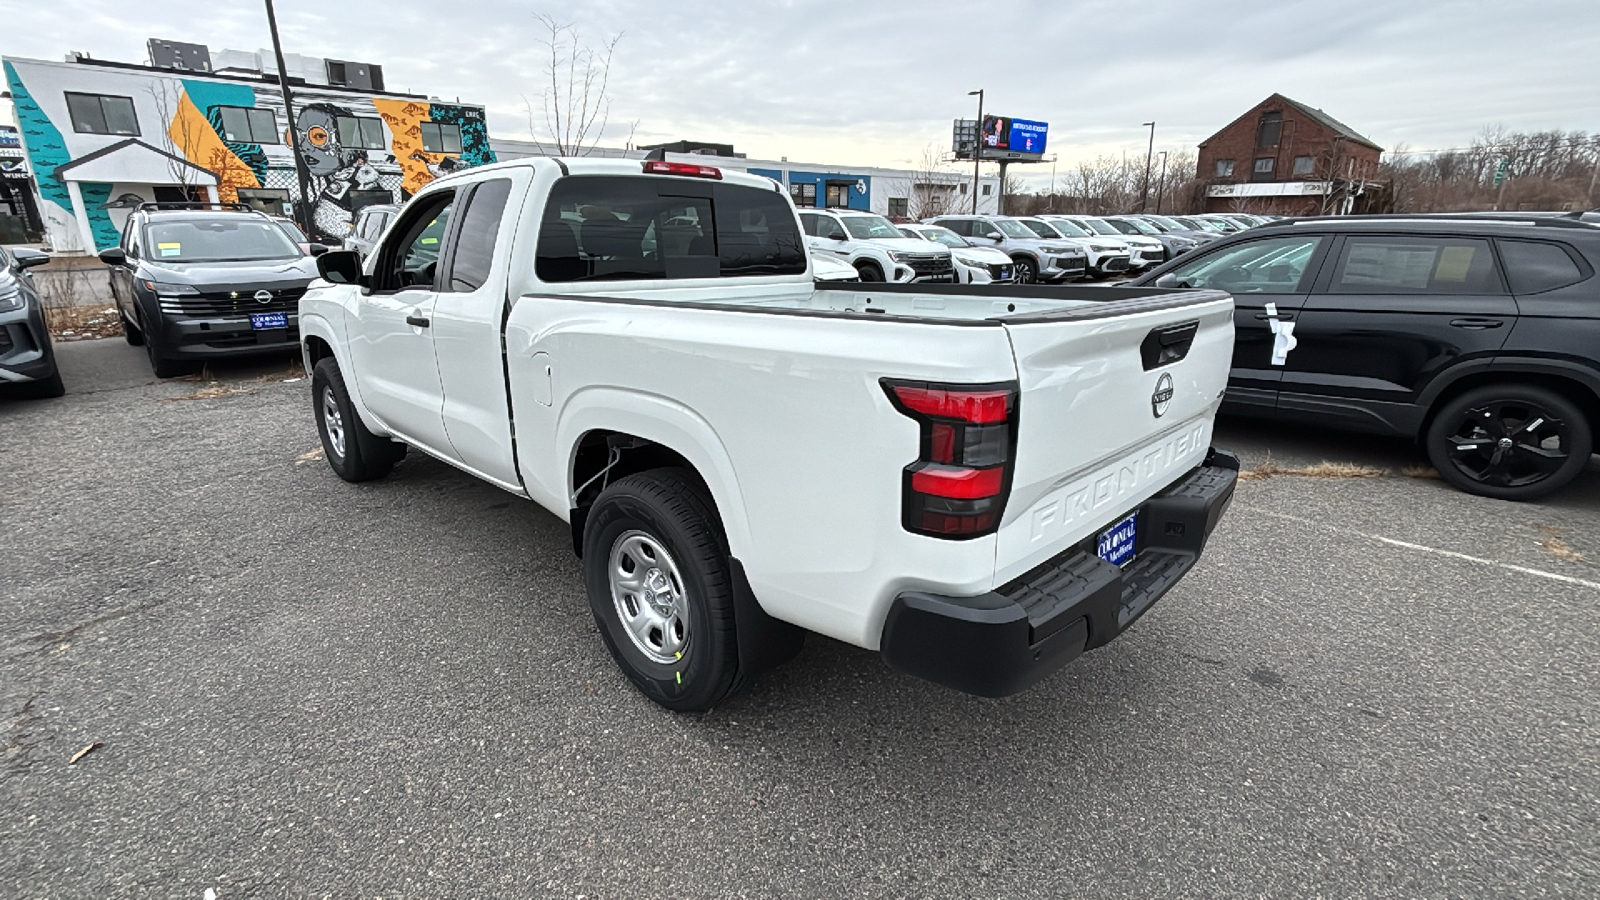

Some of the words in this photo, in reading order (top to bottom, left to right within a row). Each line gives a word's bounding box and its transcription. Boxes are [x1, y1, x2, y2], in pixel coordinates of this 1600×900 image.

[1031, 424, 1203, 543] FRONTIER
[1098, 523, 1136, 558] COLONIAL
[1110, 539, 1133, 562] Medford
